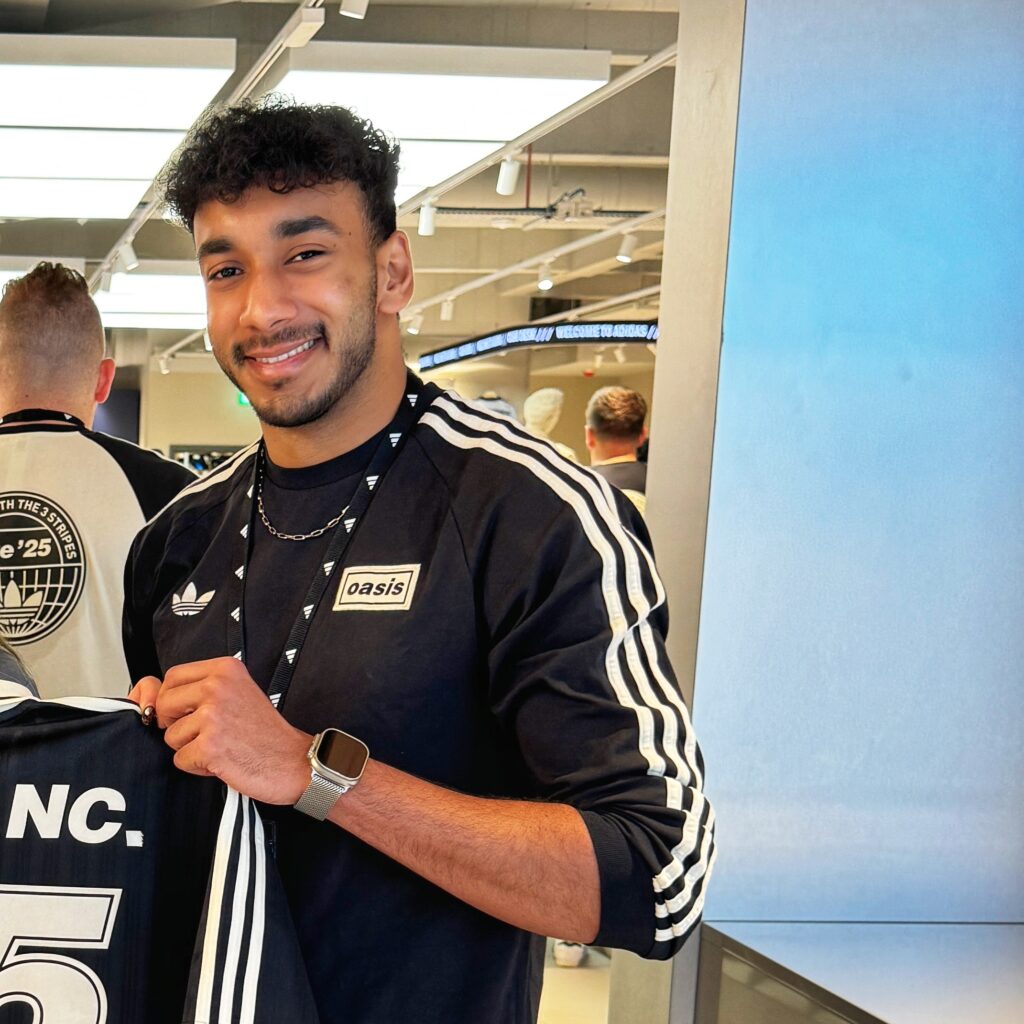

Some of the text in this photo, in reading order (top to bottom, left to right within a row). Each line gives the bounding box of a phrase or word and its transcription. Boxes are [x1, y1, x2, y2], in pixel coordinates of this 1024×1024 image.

[18, 499, 41, 514] THE
[40, 506, 48, 517] 3
[47, 512, 77, 560] STRIPES
[17, 538, 52, 558] '25
[347, 578, 405, 596] oasis
